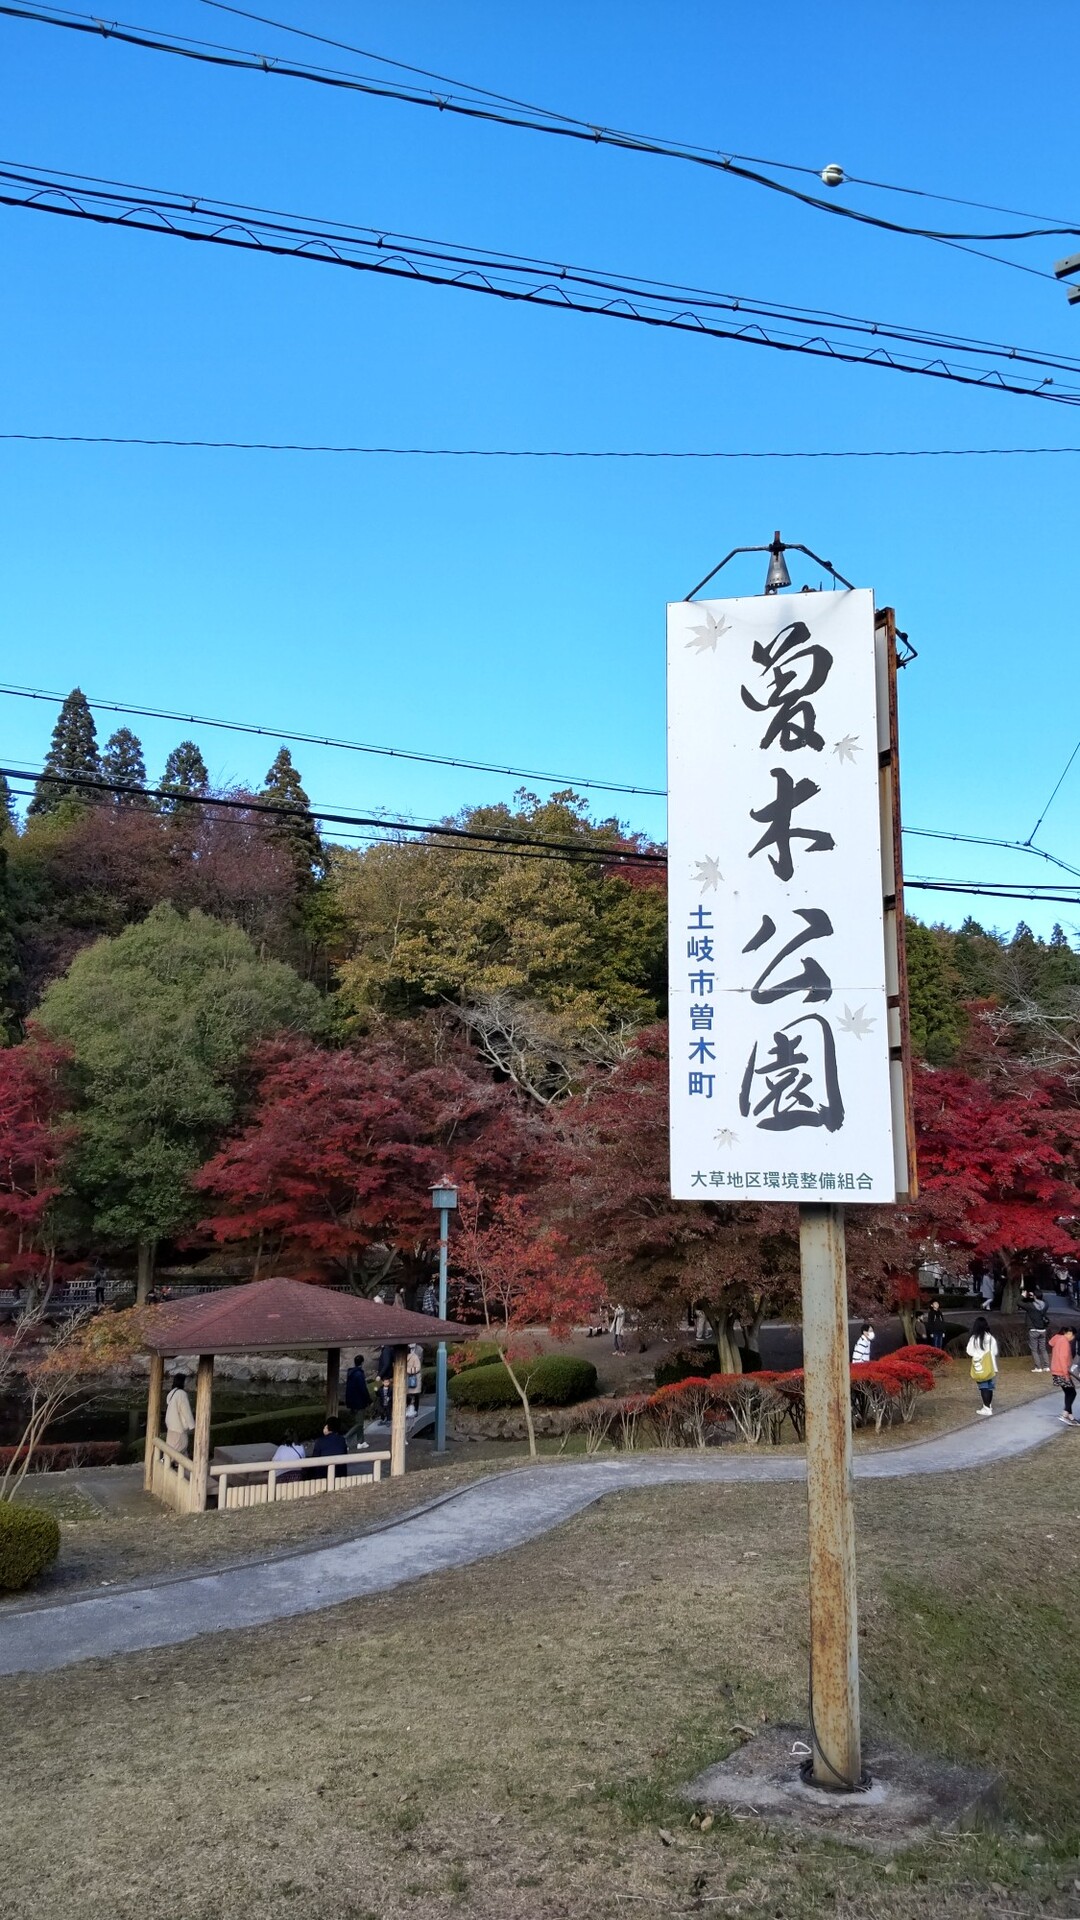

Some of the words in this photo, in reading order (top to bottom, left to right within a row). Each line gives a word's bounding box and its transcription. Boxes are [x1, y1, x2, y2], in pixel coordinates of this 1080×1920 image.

[687, 904, 716, 1099] 土岐市曽木町
[690, 1170, 874, 1190] 大草地区環境整備組合
